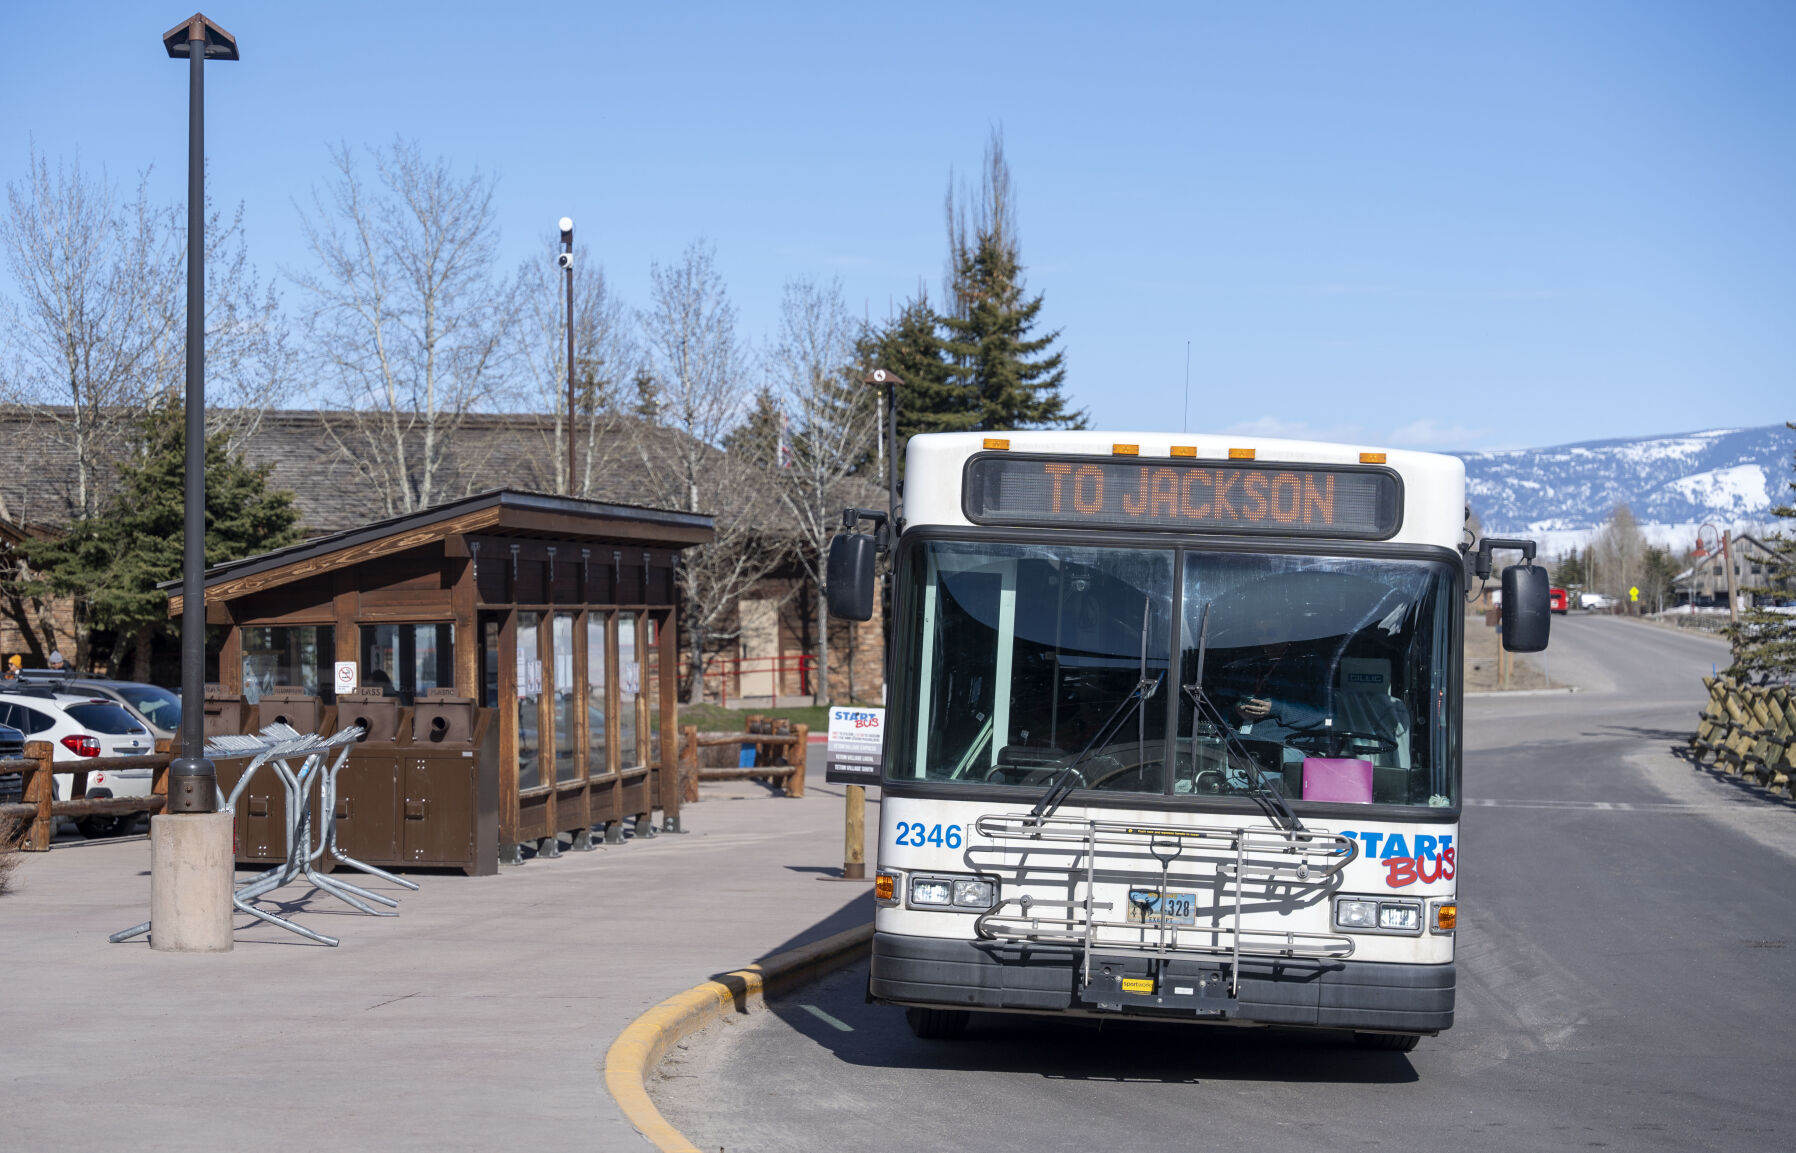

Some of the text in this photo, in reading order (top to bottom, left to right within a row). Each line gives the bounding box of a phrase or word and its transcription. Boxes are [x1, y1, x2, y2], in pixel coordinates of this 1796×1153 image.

[1045, 463, 1335, 525] TO JACKSON
[835, 711, 876, 721] START
[855, 718, 879, 728] BUS
[895, 821, 962, 849] 2346
[1335, 830, 1453, 861] START
[1381, 847, 1456, 888] BUS
